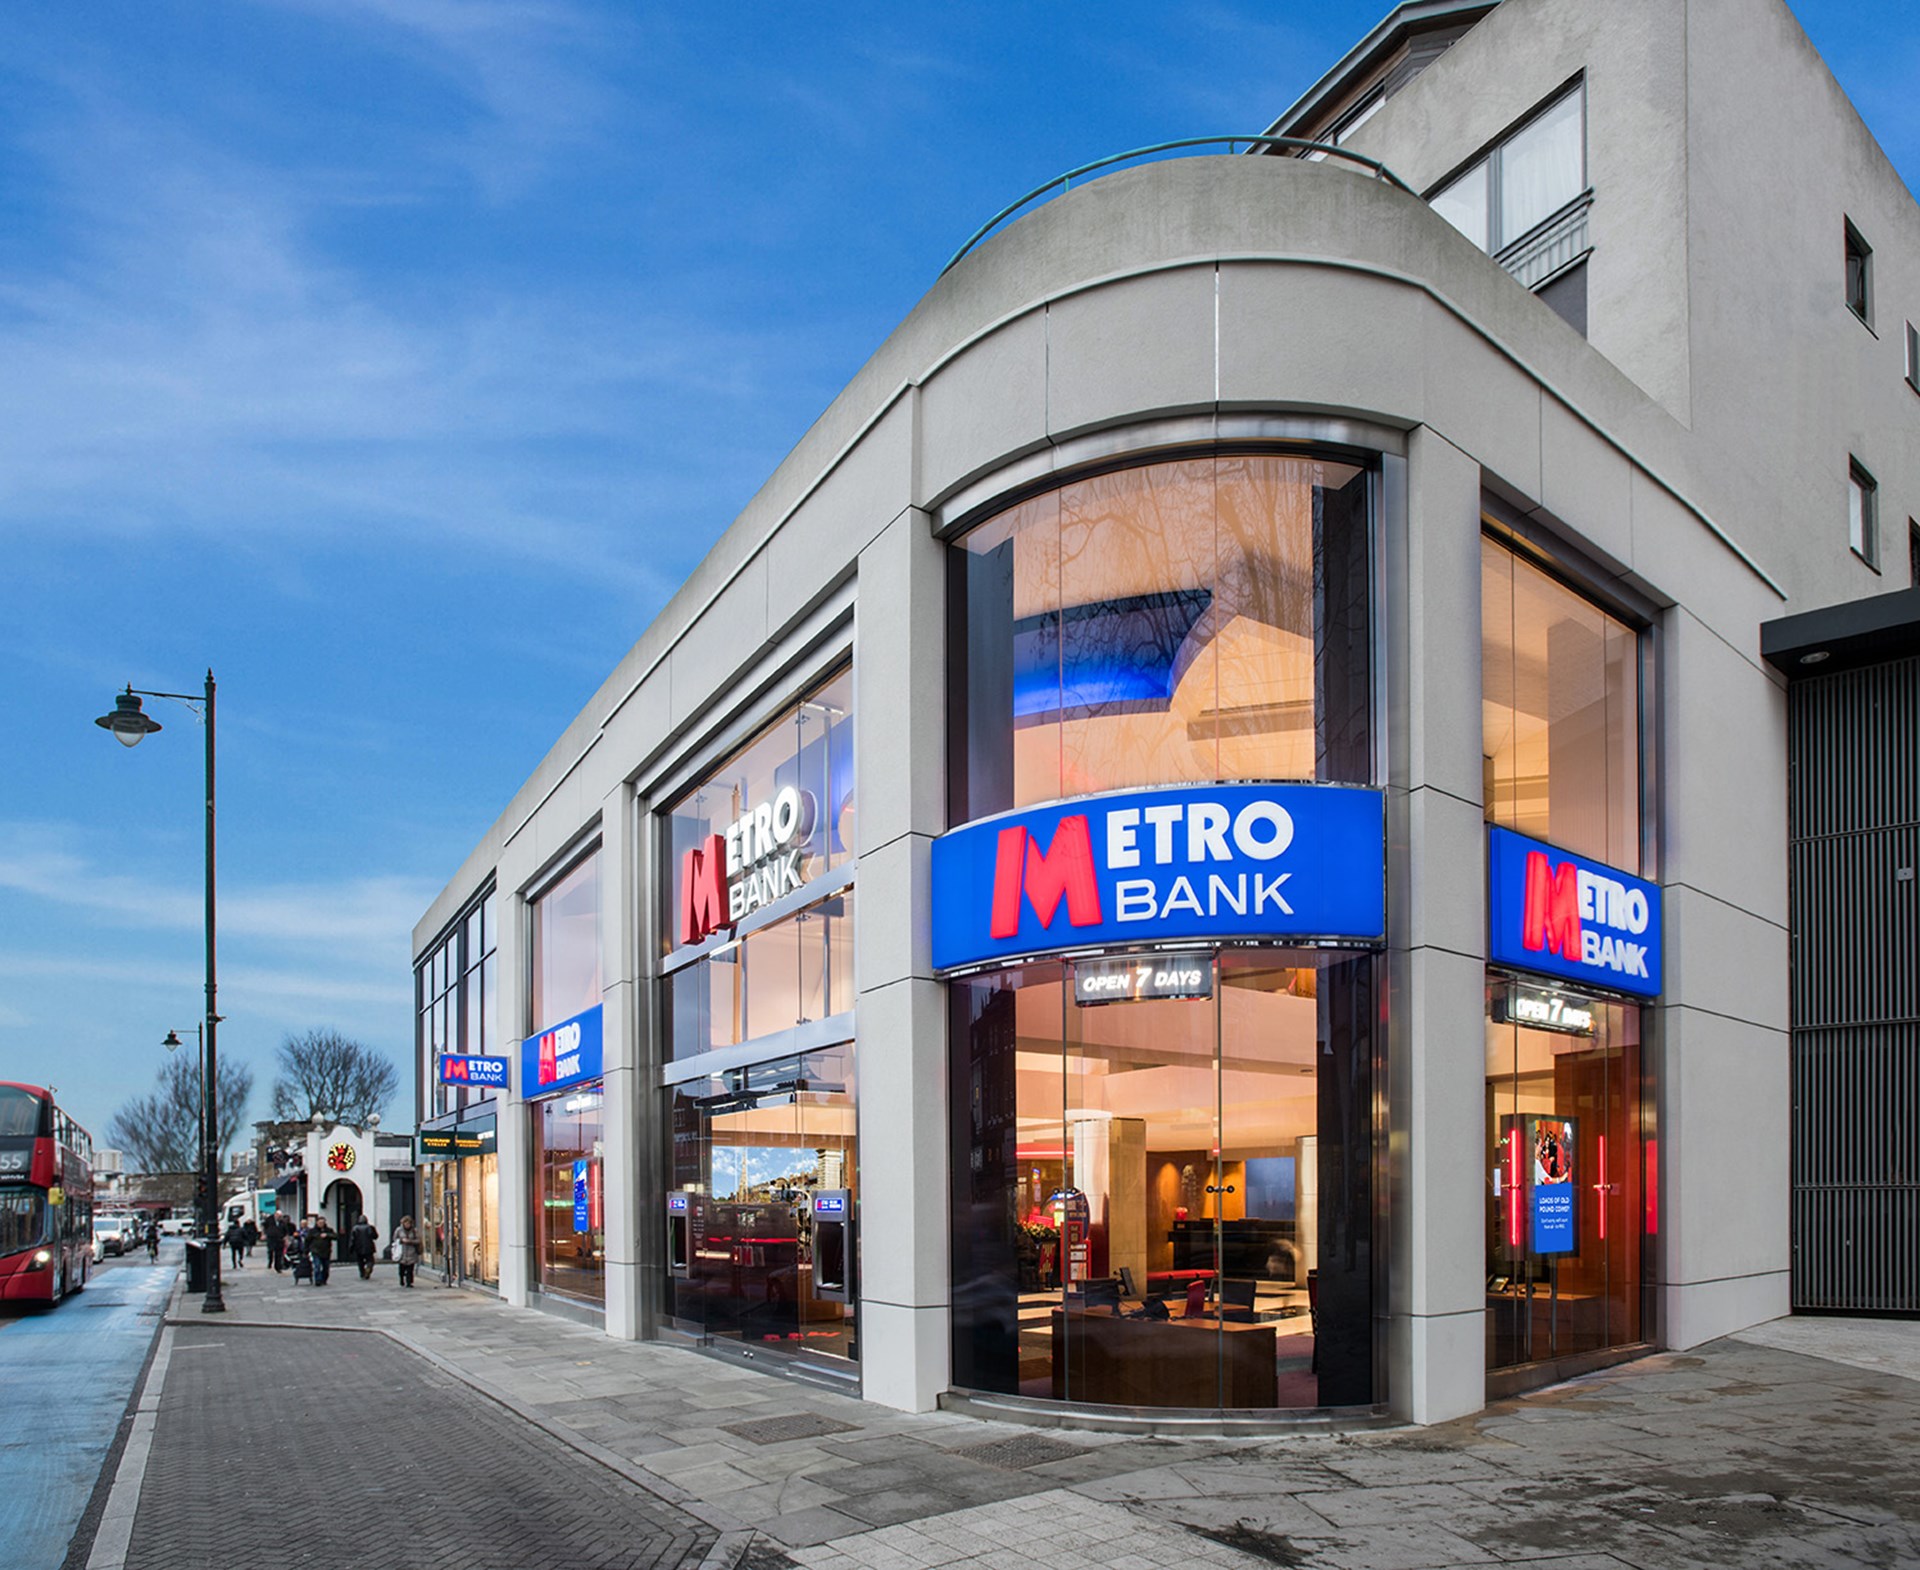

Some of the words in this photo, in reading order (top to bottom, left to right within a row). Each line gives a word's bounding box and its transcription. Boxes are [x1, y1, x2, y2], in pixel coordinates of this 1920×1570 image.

[681, 785, 801, 946] METRO
[729, 848, 804, 922] BANK
[990, 800, 1294, 939] METRO
[1116, 873, 1294, 922] BANK
[1523, 850, 1648, 962] METRO
[1581, 929, 1649, 978] BANK
[1083, 974, 1130, 992] OPEN
[1135, 966, 1153, 988] 7
[1154, 969, 1202, 987] DAYS
[1549, 998, 1564, 1022] 7
[444, 1058, 503, 1081] METRO
[470, 1072, 503, 1082] BANK
[538, 1022, 581, 1085] METRO
[556, 1053, 581, 1080] BANK
